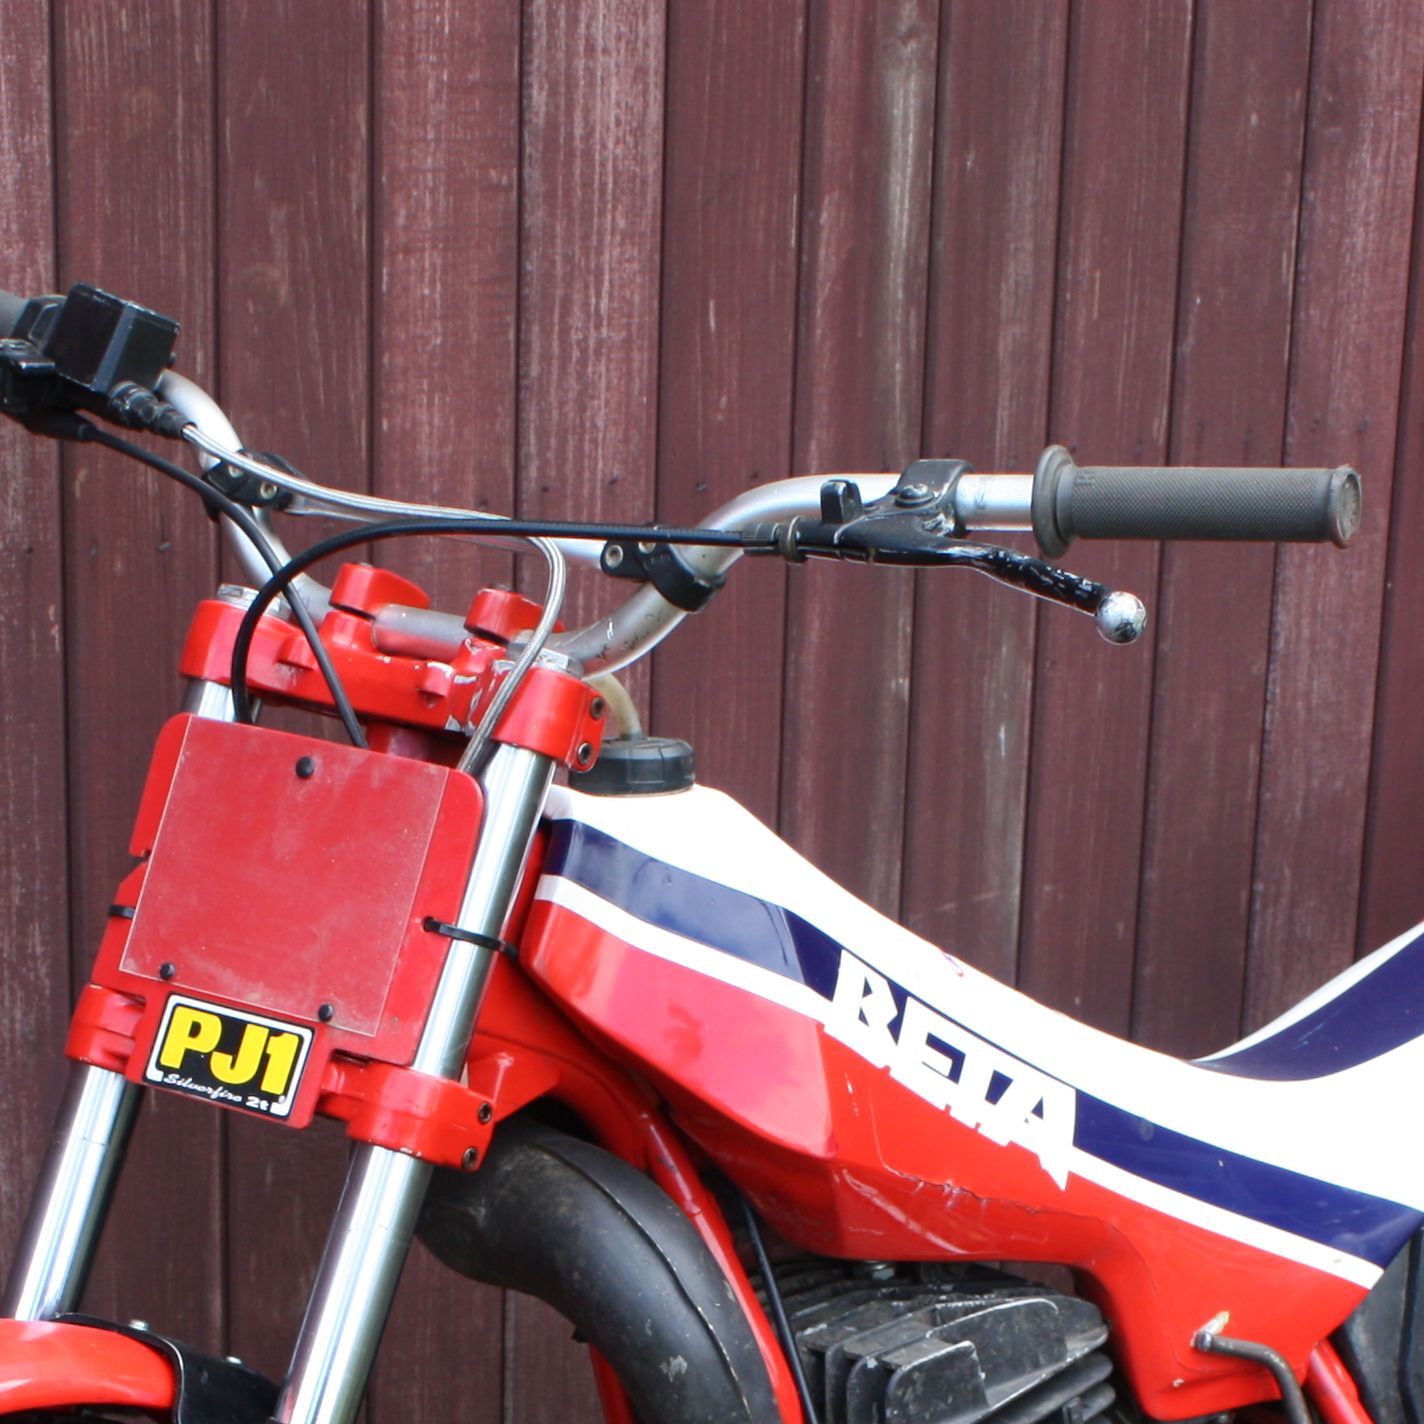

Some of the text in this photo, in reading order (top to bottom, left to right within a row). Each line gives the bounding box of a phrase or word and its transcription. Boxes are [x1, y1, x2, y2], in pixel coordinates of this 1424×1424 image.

[159, 1005, 300, 1096] PJ1
[163, 1073, 243, 1102] Silverfire
[824, 948, 1077, 1192] BETA
